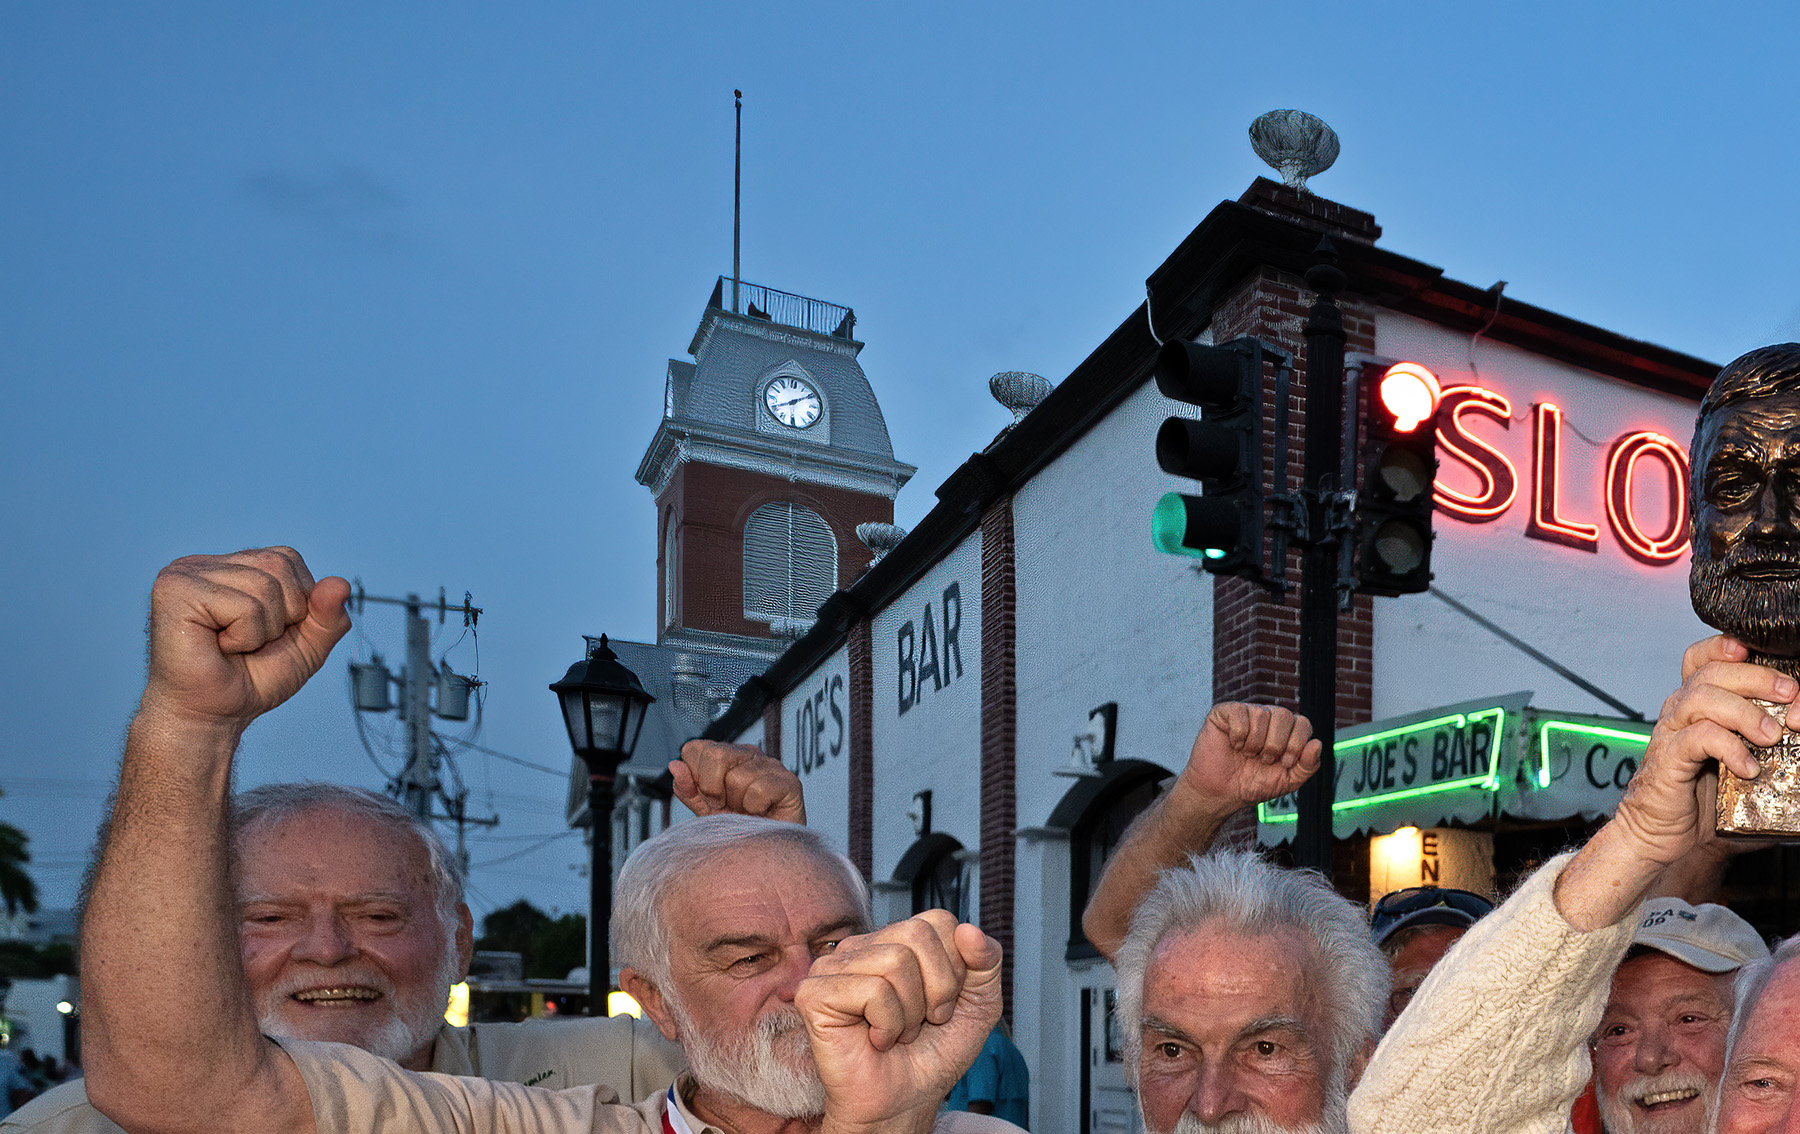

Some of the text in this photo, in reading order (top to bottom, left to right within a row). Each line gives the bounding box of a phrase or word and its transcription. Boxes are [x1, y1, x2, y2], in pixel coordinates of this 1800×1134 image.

[897, 580, 964, 718] BAR
[791, 672, 844, 776] JOE'S
[1431, 721, 1491, 781] BAR
[1585, 742, 1638, 790] Co
